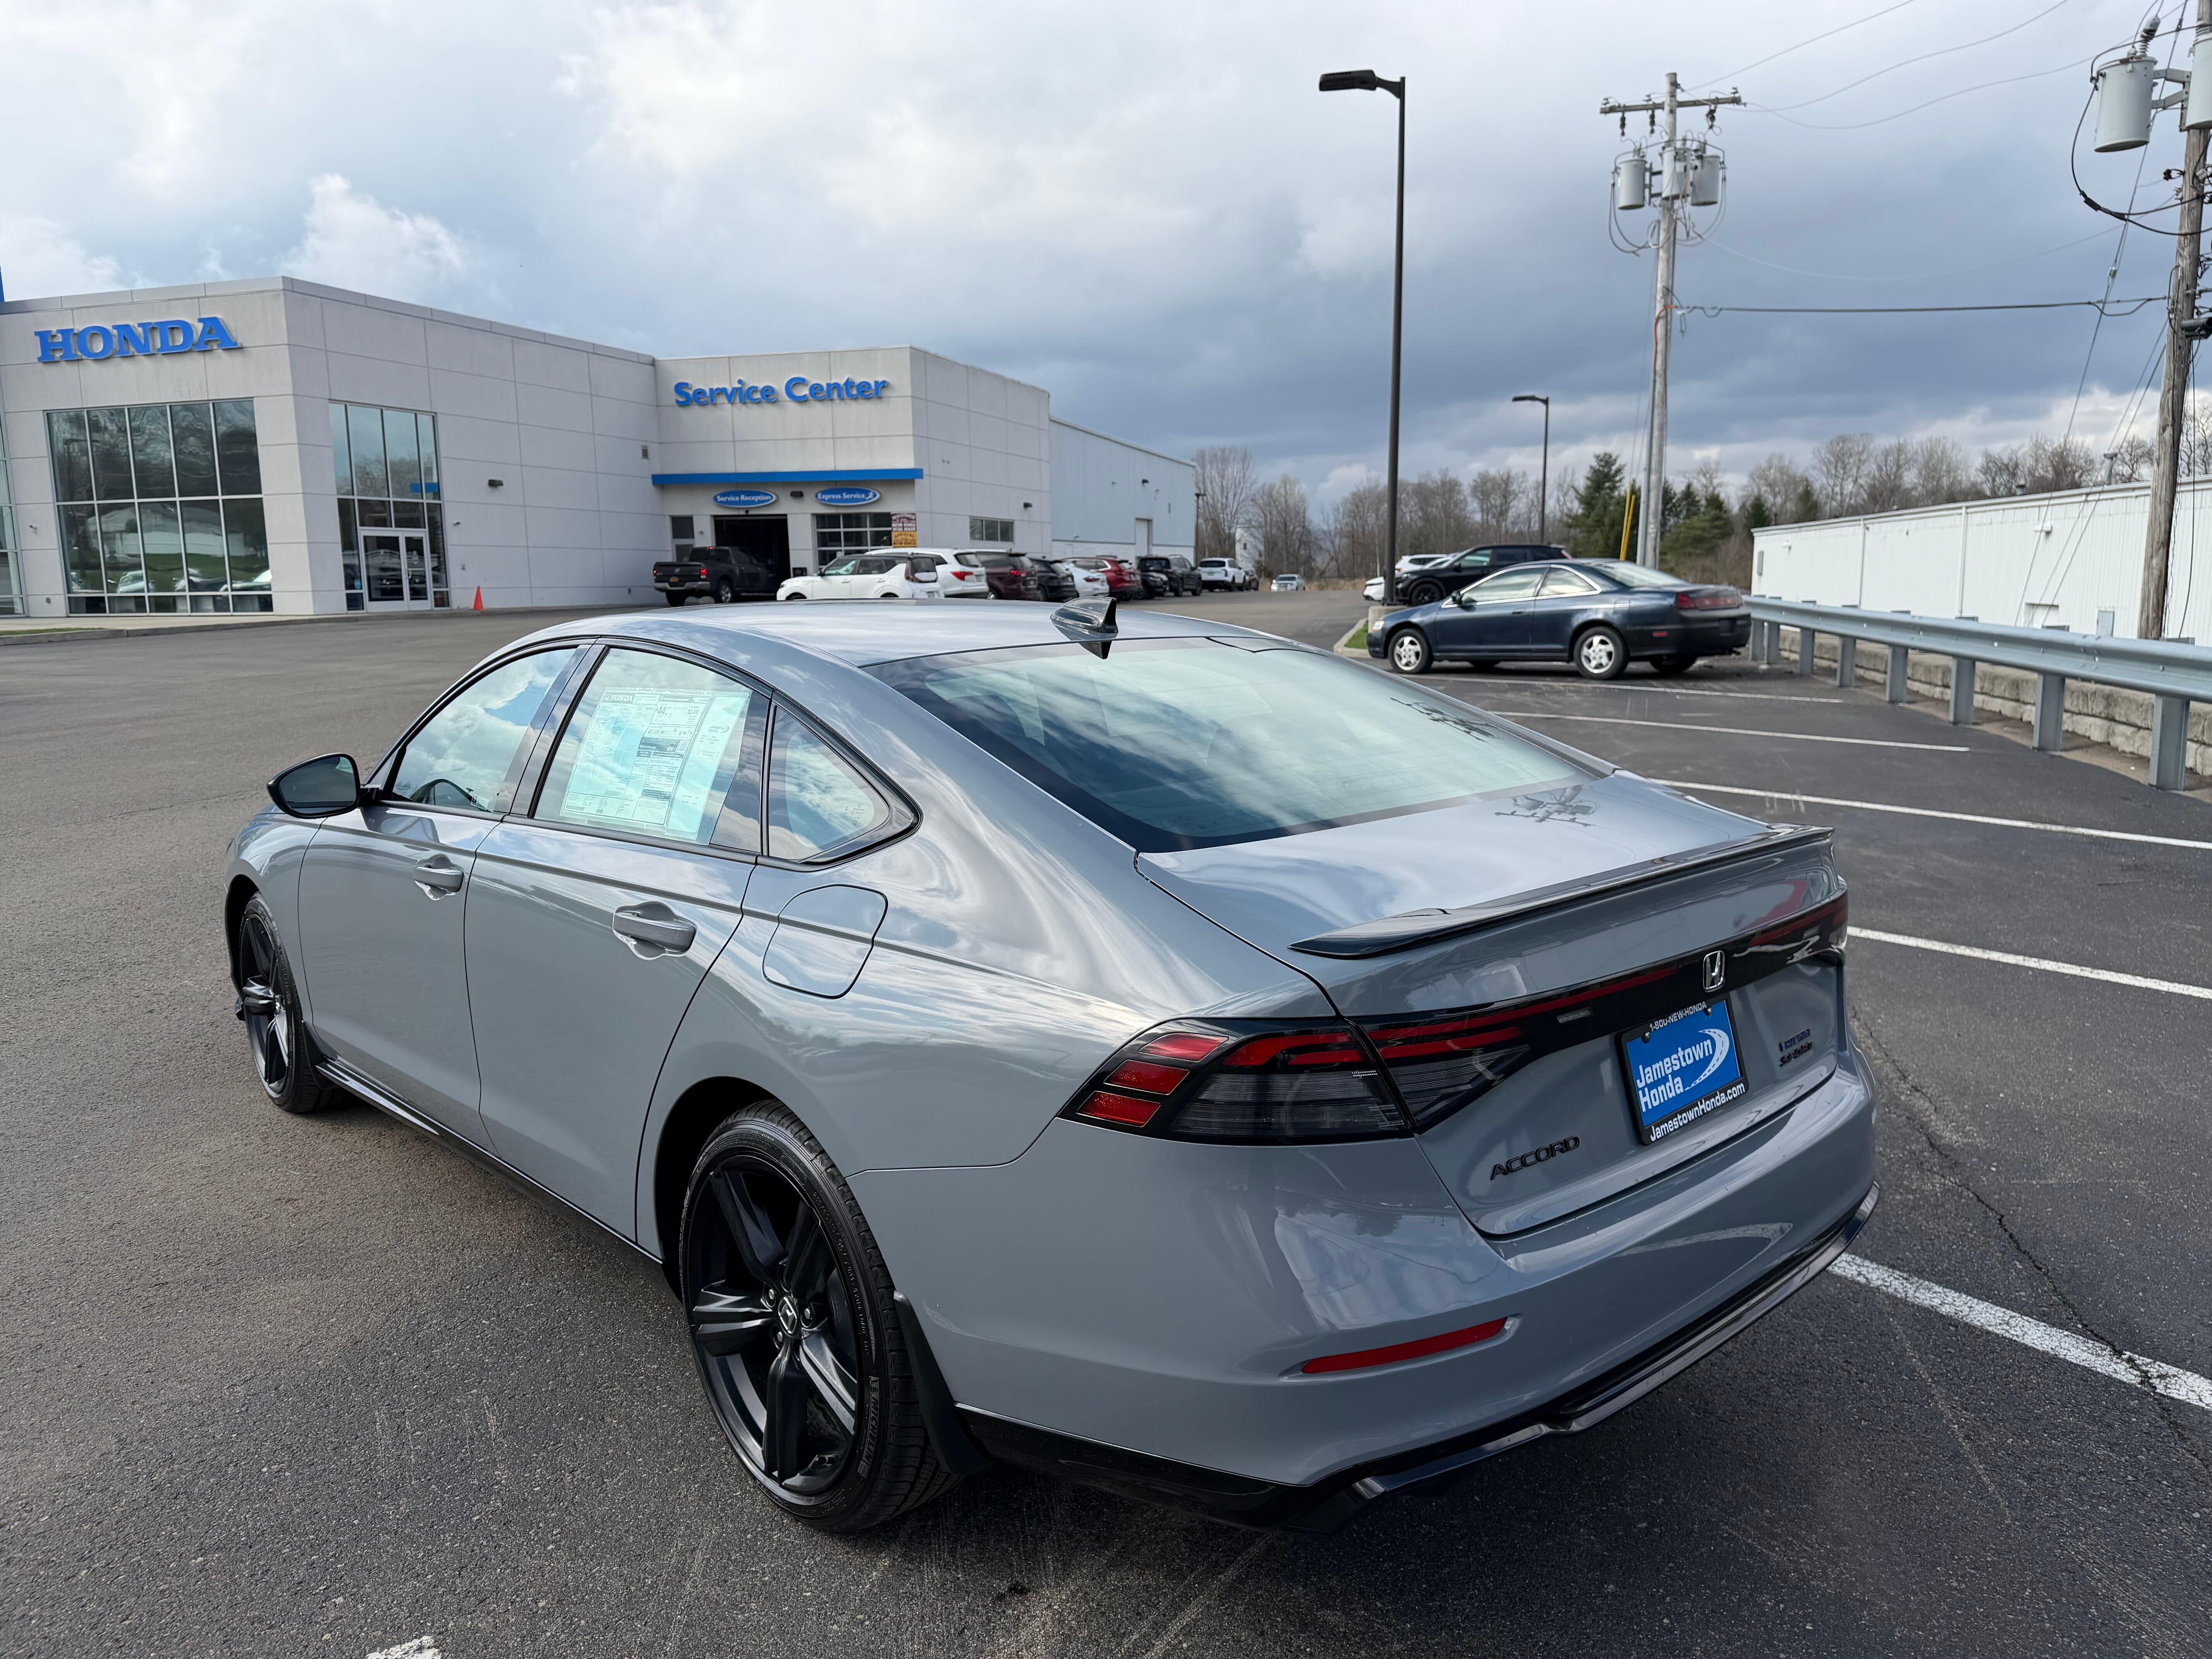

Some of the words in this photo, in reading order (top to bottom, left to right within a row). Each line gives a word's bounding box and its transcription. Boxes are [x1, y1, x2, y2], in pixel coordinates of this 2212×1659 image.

[34, 316, 239, 362] HONDA
[673, 379, 777, 406] Service
[785, 377, 887, 402] Center
[657, 706, 666, 715] 44
[1649, 1001, 1707, 1032] 1-800-NEW-HONDA
[1636, 1039, 1713, 1089] Jamestown
[1638, 1074, 1684, 1113] Honda
[1650, 1082, 1746, 1142] JamestownHonda.com
[1490, 1135, 1580, 1181] ACCORD
[864, 1396, 879, 1464] MICHELIN
